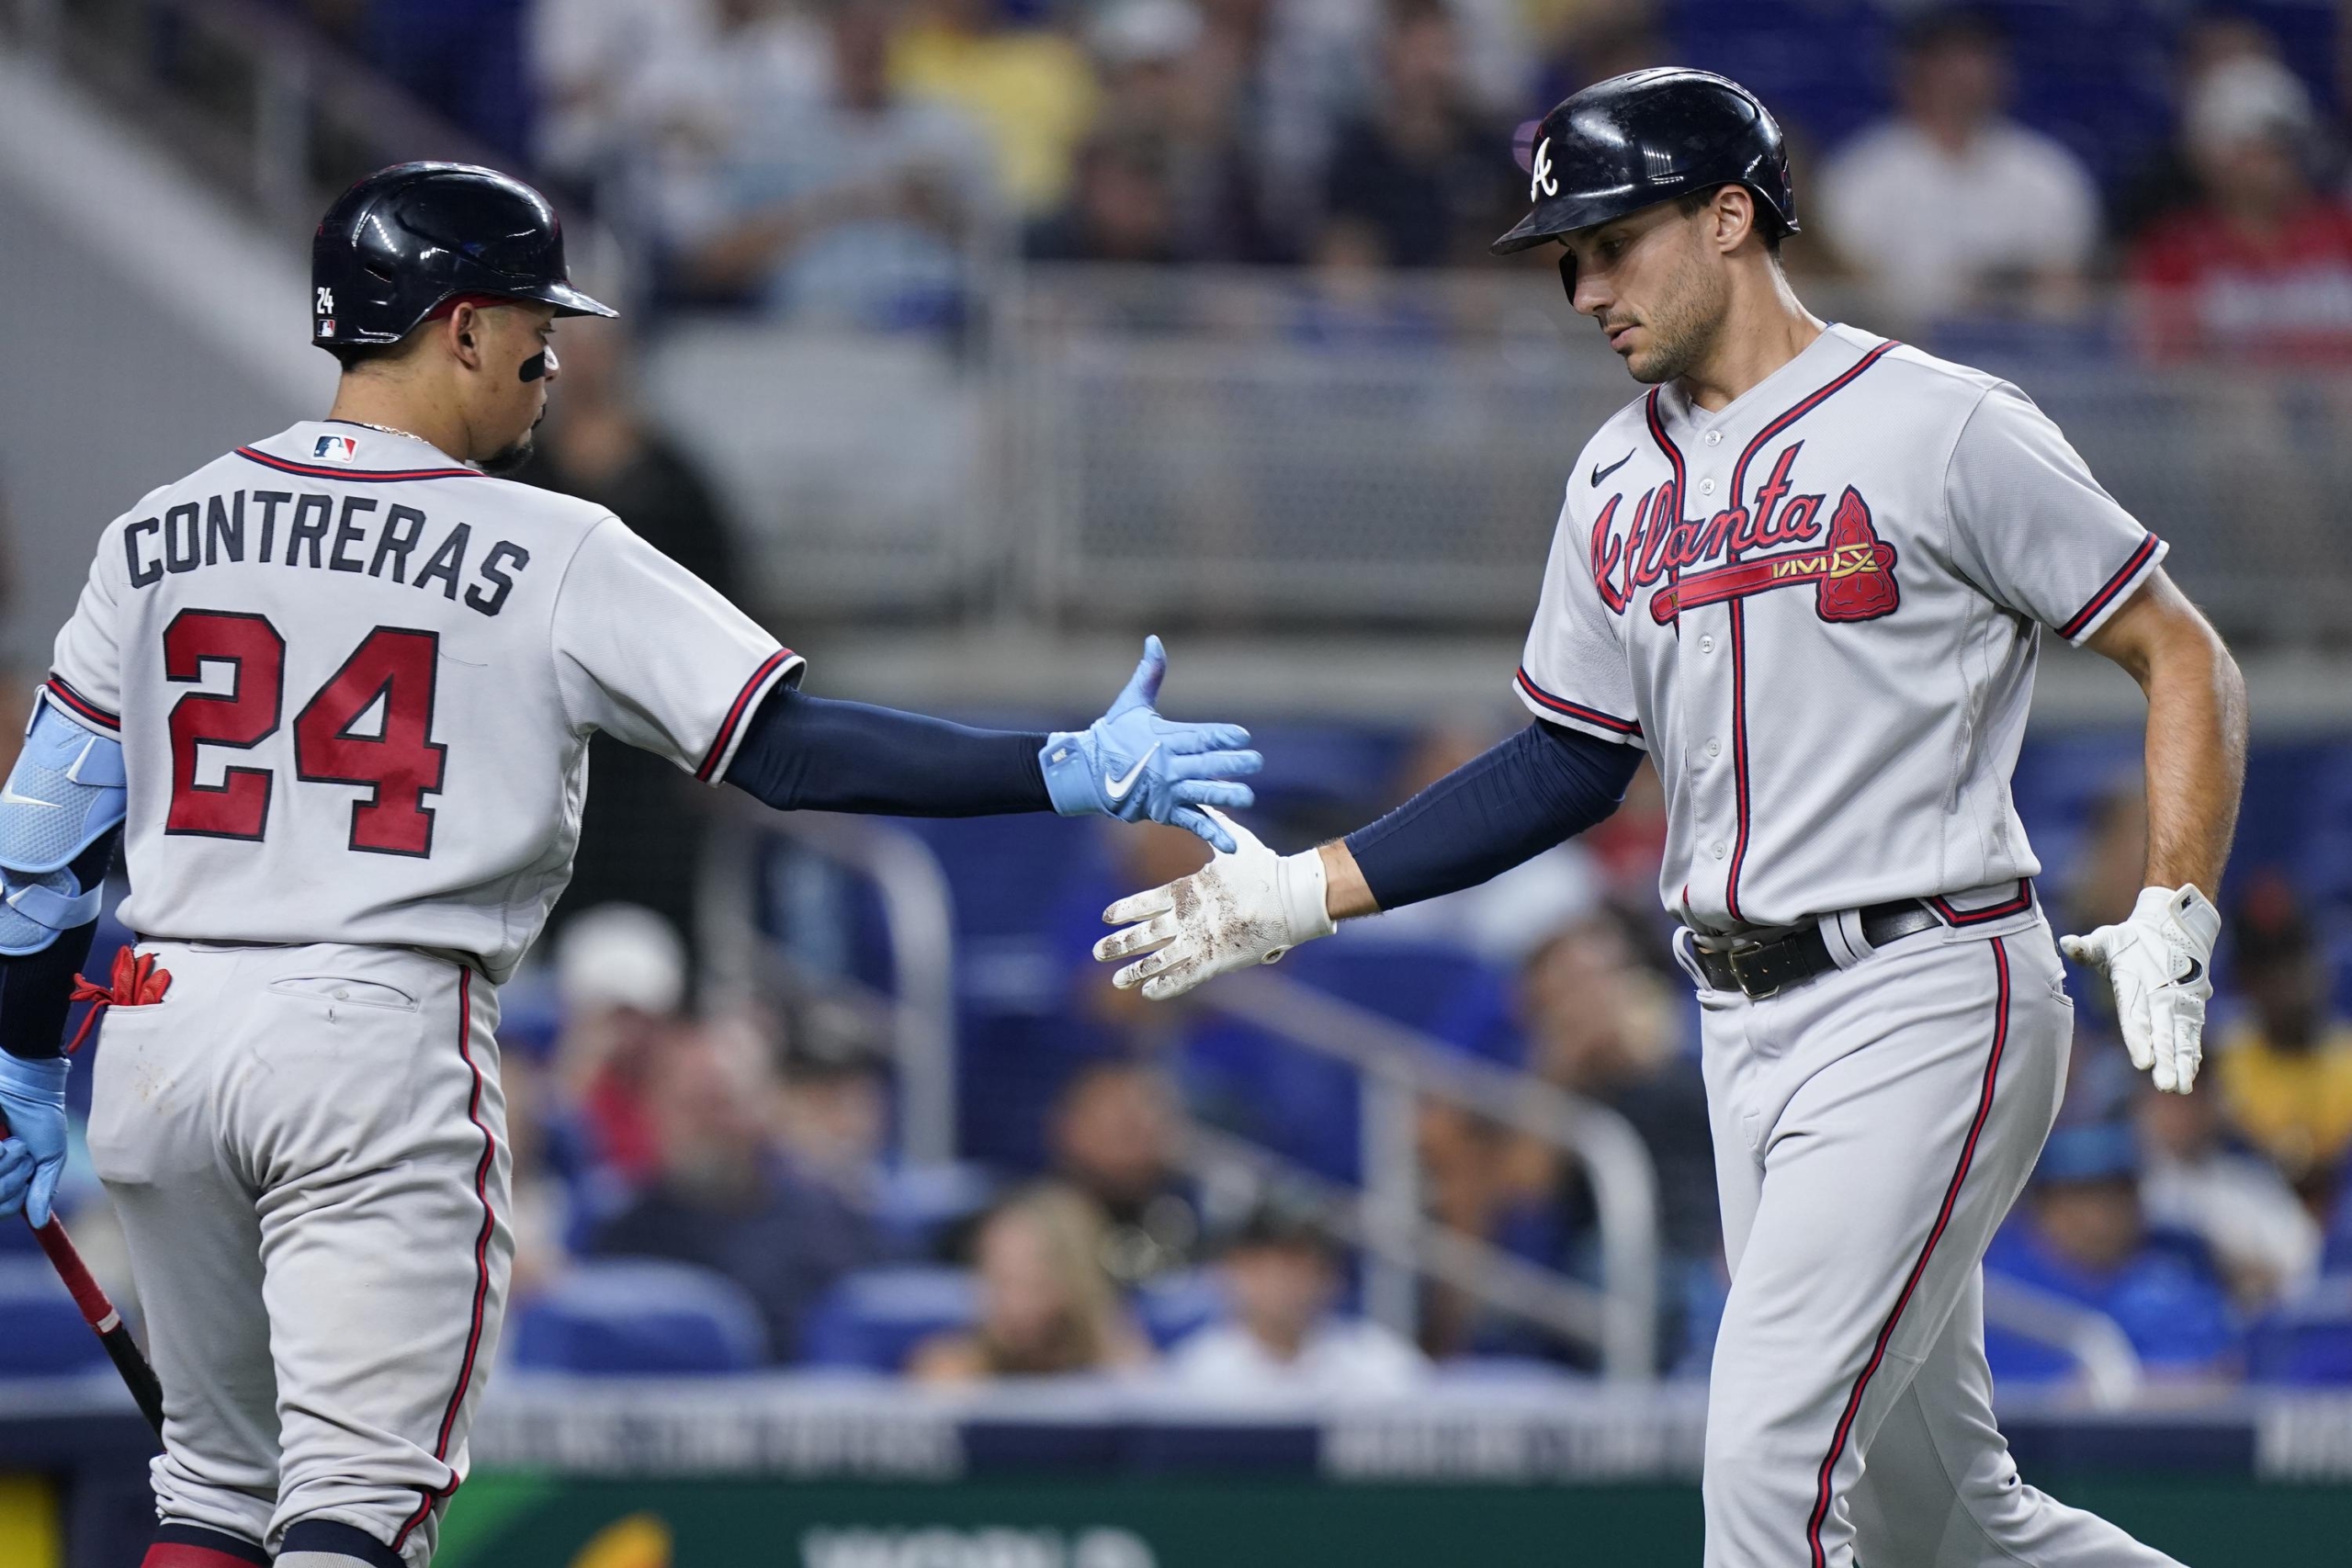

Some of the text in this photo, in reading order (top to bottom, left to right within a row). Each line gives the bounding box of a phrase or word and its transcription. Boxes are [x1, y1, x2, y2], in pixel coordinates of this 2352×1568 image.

[1531, 137, 1558, 203] A
[316, 287, 334, 314] 24
[124, 490, 530, 616] CONTRERAS
[1591, 439, 1826, 615] Atlanta
[163, 607, 448, 859] 24
